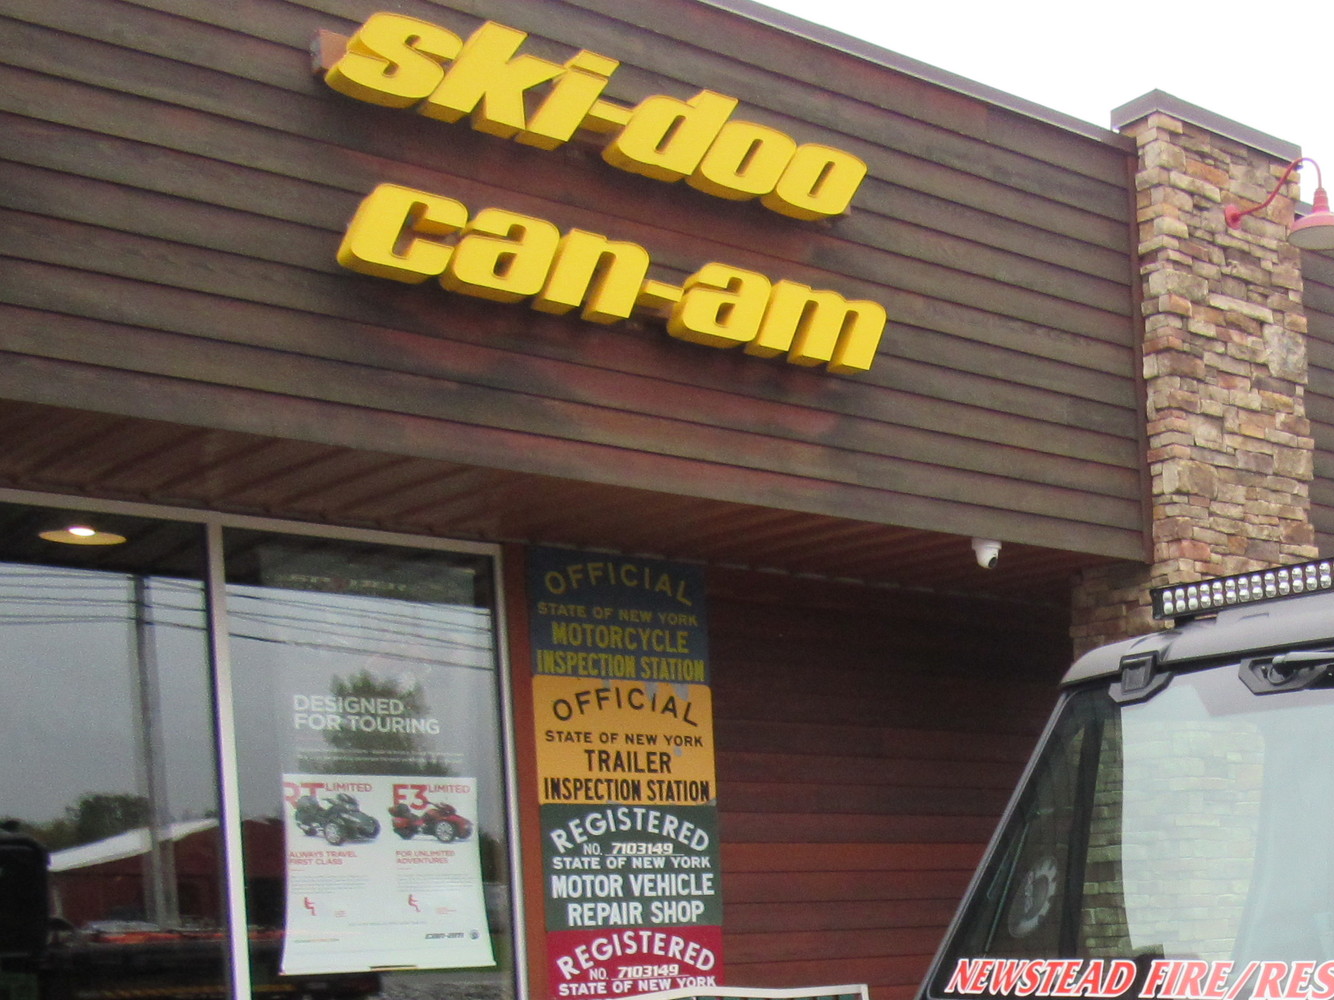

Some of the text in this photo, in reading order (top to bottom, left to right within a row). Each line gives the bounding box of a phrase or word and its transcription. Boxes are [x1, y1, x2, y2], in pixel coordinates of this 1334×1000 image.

[325, 12, 867, 220] ski-doo
[337, 182, 886, 374] can-am
[544, 561, 693, 607] OFFICIAL
[537, 602, 698, 627] STATE OF NEW YORK
[551, 621, 690, 654] MOTORCYCLE
[536, 650, 705, 682] INSPECTION STATION
[293, 694, 405, 716] DESIGNED
[552, 687, 699, 727] OFFICIAL
[294, 713, 440, 735] FOR TOURING
[545, 730, 703, 748] STATE OF NEW YORK
[584, 749, 672, 774] TRAILER
[325, 783, 373, 793] LIMITED
[428, 784, 471, 794] LIMITED
[544, 777, 711, 802] INSPECTION STATION
[550, 807, 710, 854] REGISTERED
[583, 842, 673, 856] NO. 7103149
[552, 856, 711, 870] STATE OF NEW YORK
[552, 873, 715, 899] MOTOR VEHICLE
[568, 900, 705, 927] REPAIR SHOP
[556, 930, 715, 981] REGISTERED
[589, 964, 680, 981] NO. 7103149
[944, 958, 1137, 998] NEWSTEAD
[559, 976, 717, 997] STATE OF NEW YORK
